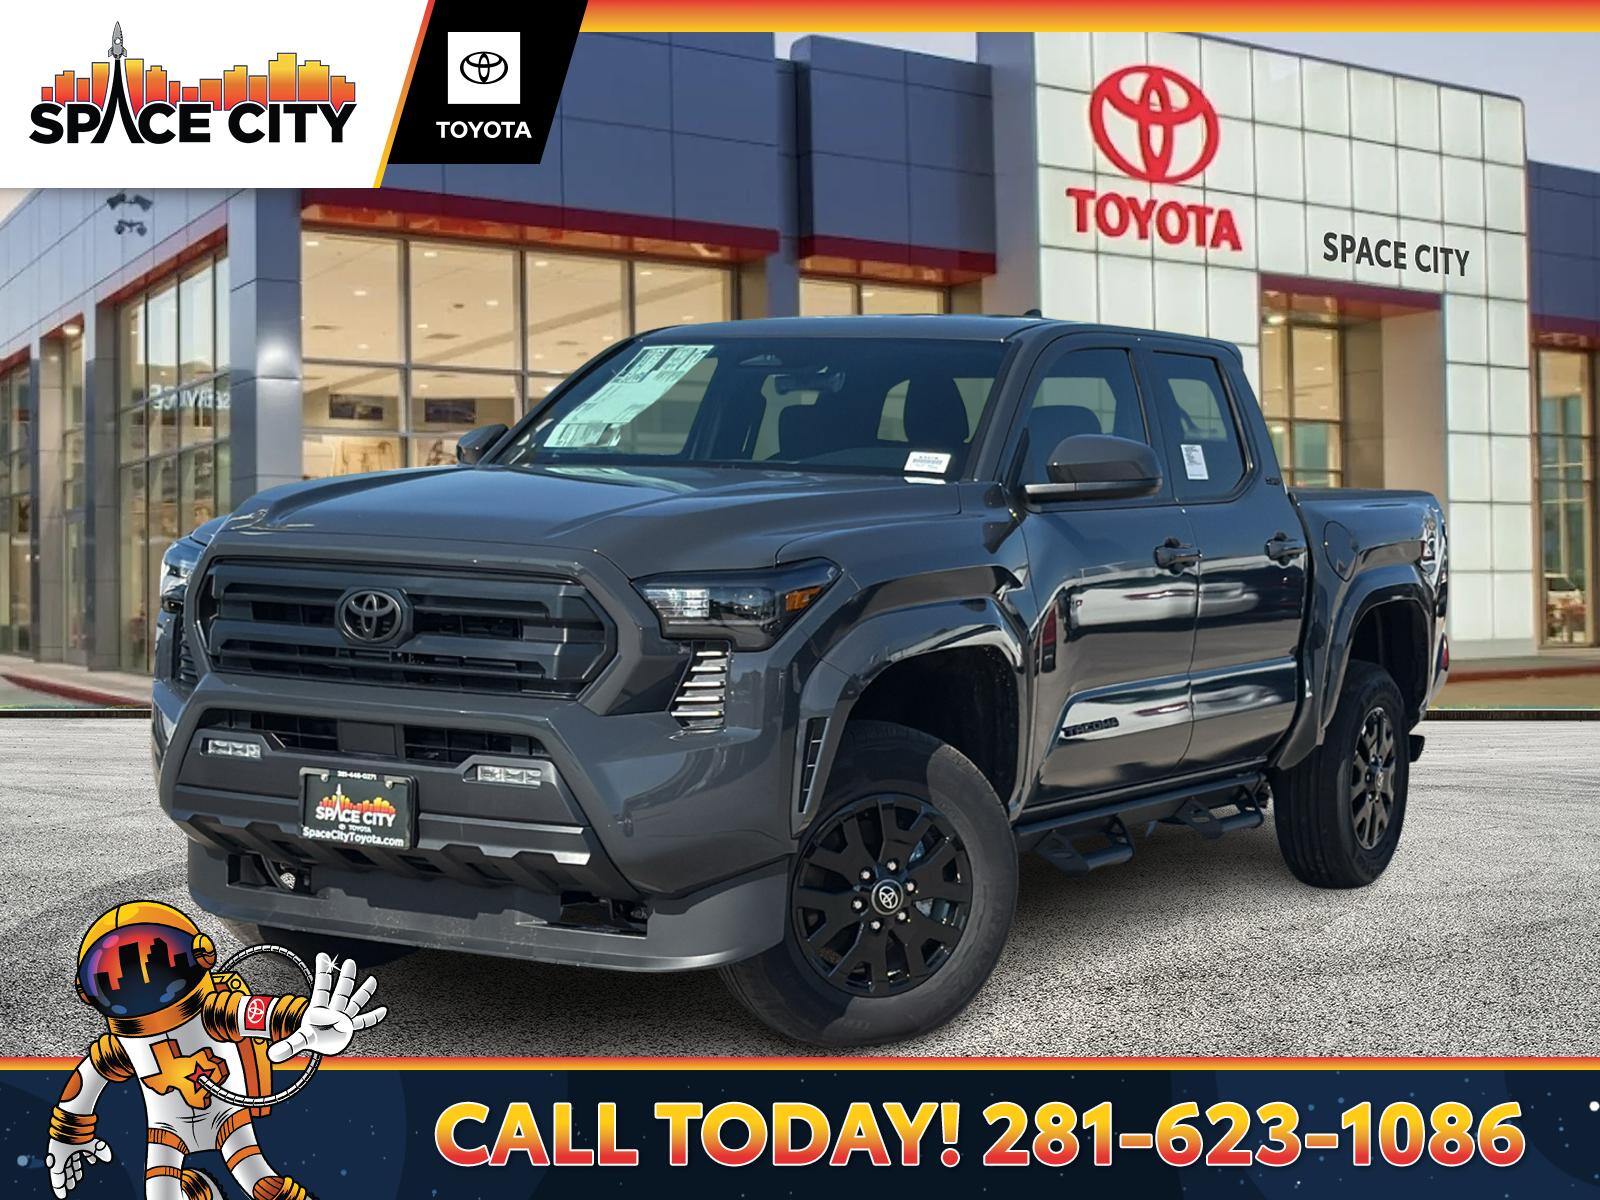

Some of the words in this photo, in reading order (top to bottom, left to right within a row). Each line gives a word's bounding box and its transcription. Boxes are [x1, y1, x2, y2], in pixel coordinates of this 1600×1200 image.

[1066, 187, 1242, 251] TOYOTA
[1323, 232, 1407, 270] SPACE
[1414, 244, 1470, 277] CITY
[348, 824, 372, 834] TOYOTA
[362, 809, 396, 828] CITY
[302, 826, 405, 847] SpaceCityToyota.com
